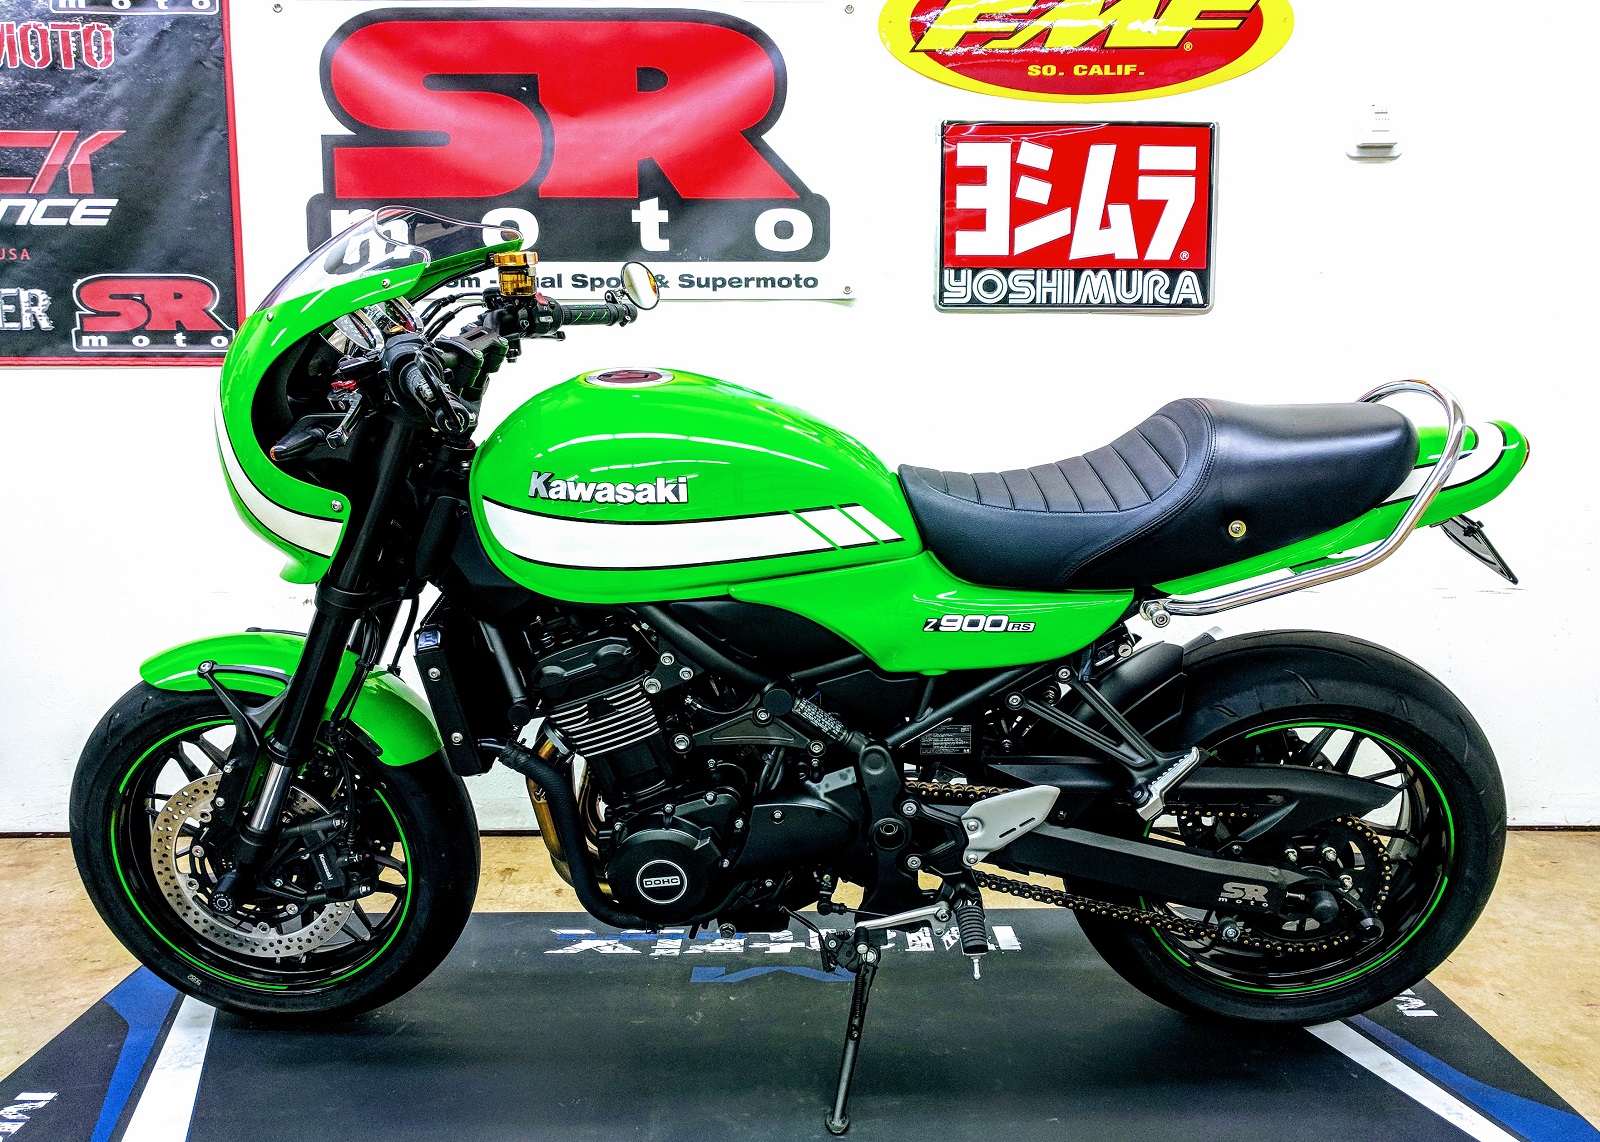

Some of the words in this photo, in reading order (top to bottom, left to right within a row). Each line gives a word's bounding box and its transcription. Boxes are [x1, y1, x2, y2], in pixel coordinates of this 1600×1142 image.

[910, 0, 1260, 52] FMF
[1027, 64, 1066, 76] SO.
[1073, 64, 1145, 76] CALIF.
[328, 20, 801, 199] SR
[954, 141, 1198, 260] ヨシムラ
[678, 273, 820, 292] Supermoto
[943, 269, 1204, 305] YOSHIMURA
[79, 278, 224, 332] SR
[82, 332, 229, 347] moto
[528, 471, 690, 504] Kawasaki
[644, 877, 680, 887] DOHC
[1220, 881, 1269, 902] SR
